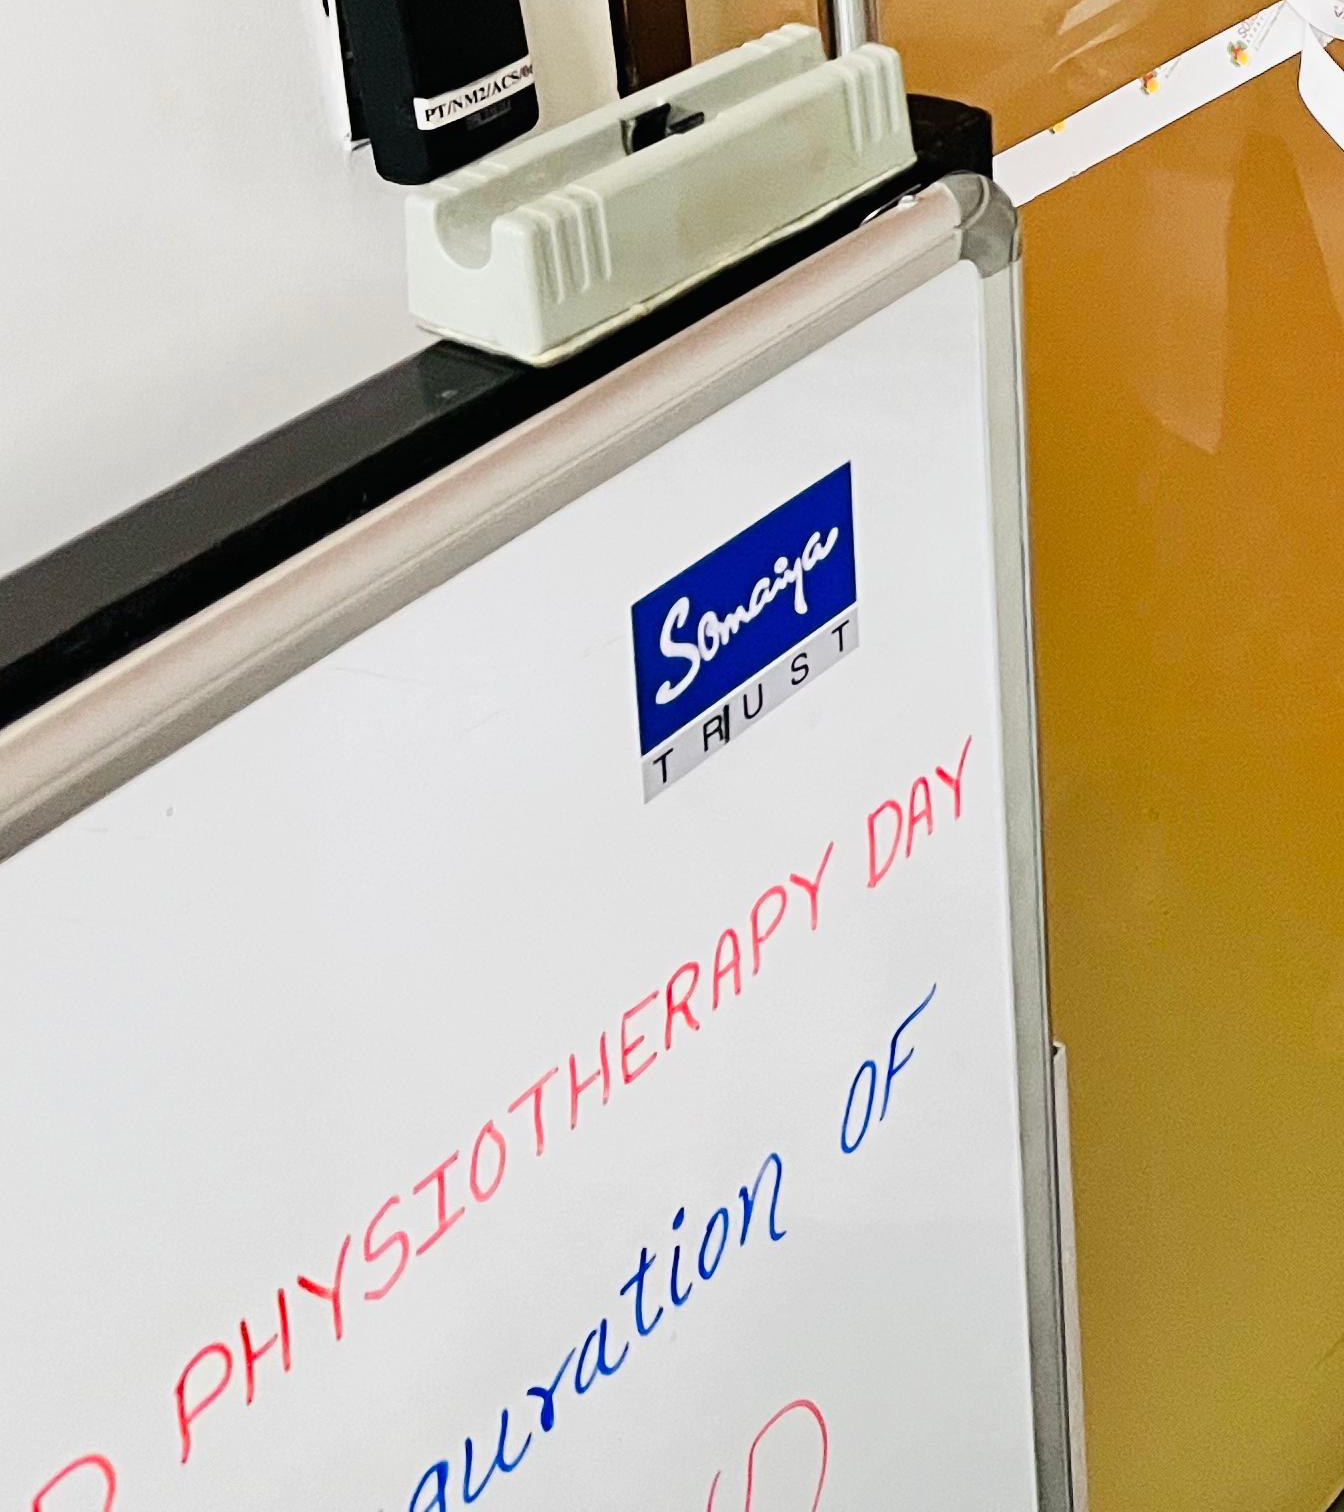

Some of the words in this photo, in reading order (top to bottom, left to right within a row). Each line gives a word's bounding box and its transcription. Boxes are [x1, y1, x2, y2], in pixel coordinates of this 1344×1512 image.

[652, 620, 851, 784] TRUST
[655, 526, 840, 705] Somaiya
[172, 841, 834, 1465] PHYSIOTHERAPY
[866, 735, 974, 888] DAY
[839, 983, 937, 1154] OF
